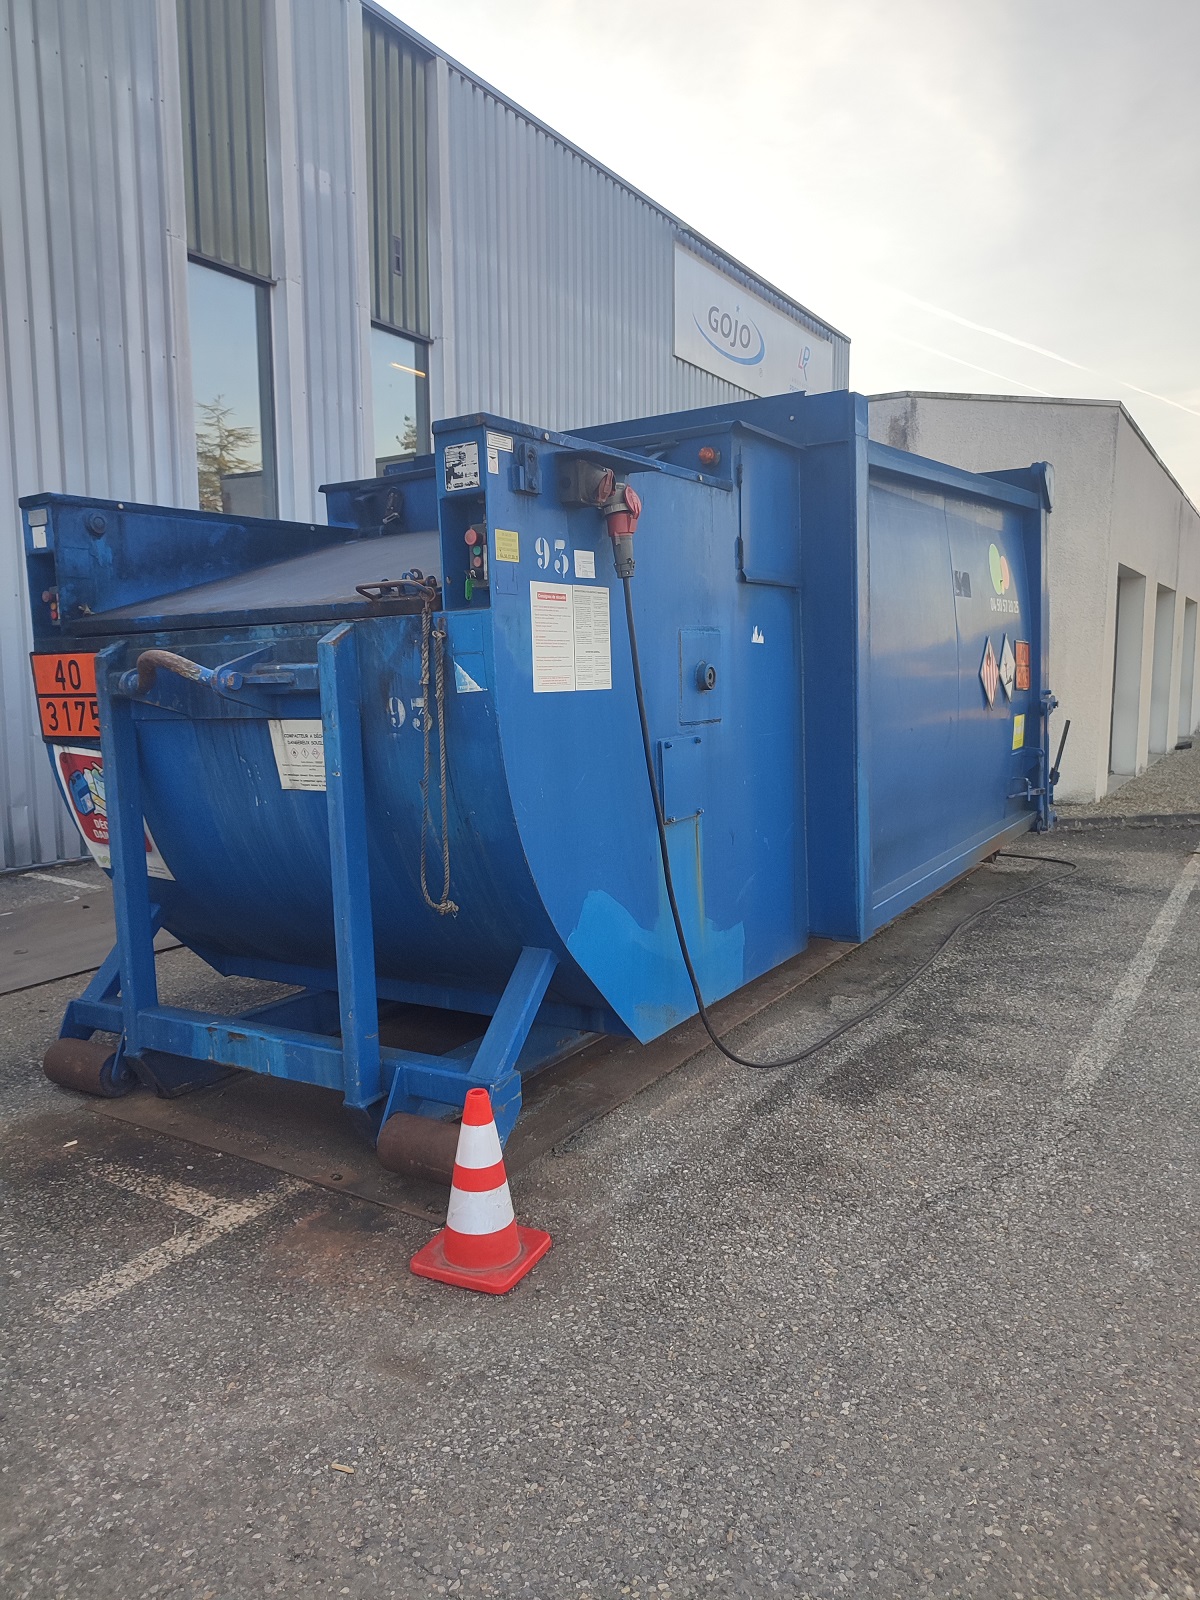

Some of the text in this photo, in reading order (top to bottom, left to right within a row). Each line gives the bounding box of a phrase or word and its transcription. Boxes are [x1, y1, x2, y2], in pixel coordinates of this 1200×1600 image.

[708, 305, 751, 349] GOJO
[55, 660, 81, 691] 40
[46, 701, 100, 731] 3175
